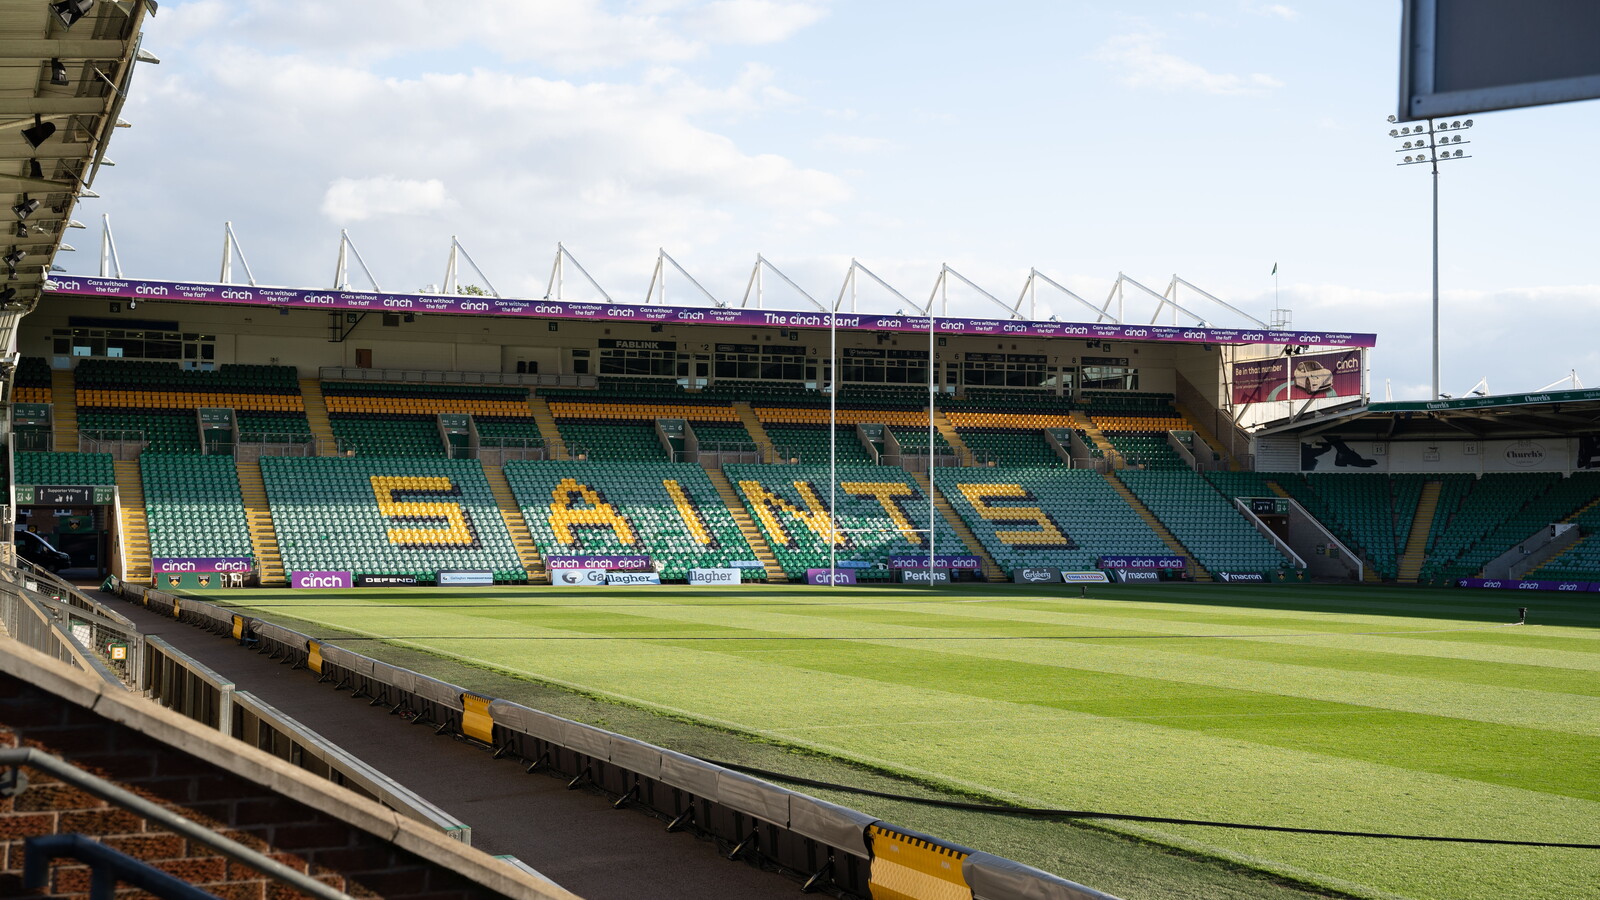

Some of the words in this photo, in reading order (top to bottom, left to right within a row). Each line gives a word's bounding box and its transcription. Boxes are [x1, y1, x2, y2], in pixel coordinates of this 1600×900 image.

[136, 283, 168, 295] cinch
[221, 288, 252, 300] cinch
[304, 292, 334, 304] cinch
[384, 296, 412, 307] cinch
[460, 300, 488, 310] cinch
[535, 303, 562, 314] cinch
[608, 306, 634, 317] cinch
[678, 309, 704, 320] cinch
[764, 313, 786, 324] The
[790, 313, 820, 326] cinch
[877, 317, 901, 327] cinch
[940, 320, 964, 330] cinch
[1004, 322, 1027, 332] cinch
[1065, 325, 1088, 334] cinch
[1124, 327, 1147, 336] cinch
[1184, 330, 1206, 340] cinch
[1242, 331, 1264, 340] cinch
[1299, 332, 1320, 342] cinch
[1336, 356, 1358, 369] cinch
[1261, 365, 1282, 373] number
[162, 560, 195, 571] cinch
[215, 559, 247, 570] cinch
[551, 557, 579, 568] cinch
[585, 557, 612, 568] cinch
[618, 557, 646, 568] cinch
[893, 557, 917, 567] cinch
[952, 557, 976, 567] cinch
[1104, 557, 1127, 567] cinch
[1131, 558, 1154, 567] cinch
[1159, 557, 1182, 567] cinch
[301, 572, 342, 587] cinch
[1023, 569, 1051, 581] Carlsberg
[1483, 580, 1501, 588] cinch
[1519, 581, 1539, 590] cinch
[1558, 582, 1578, 591] cinch
[114, 648, 123, 658] B
